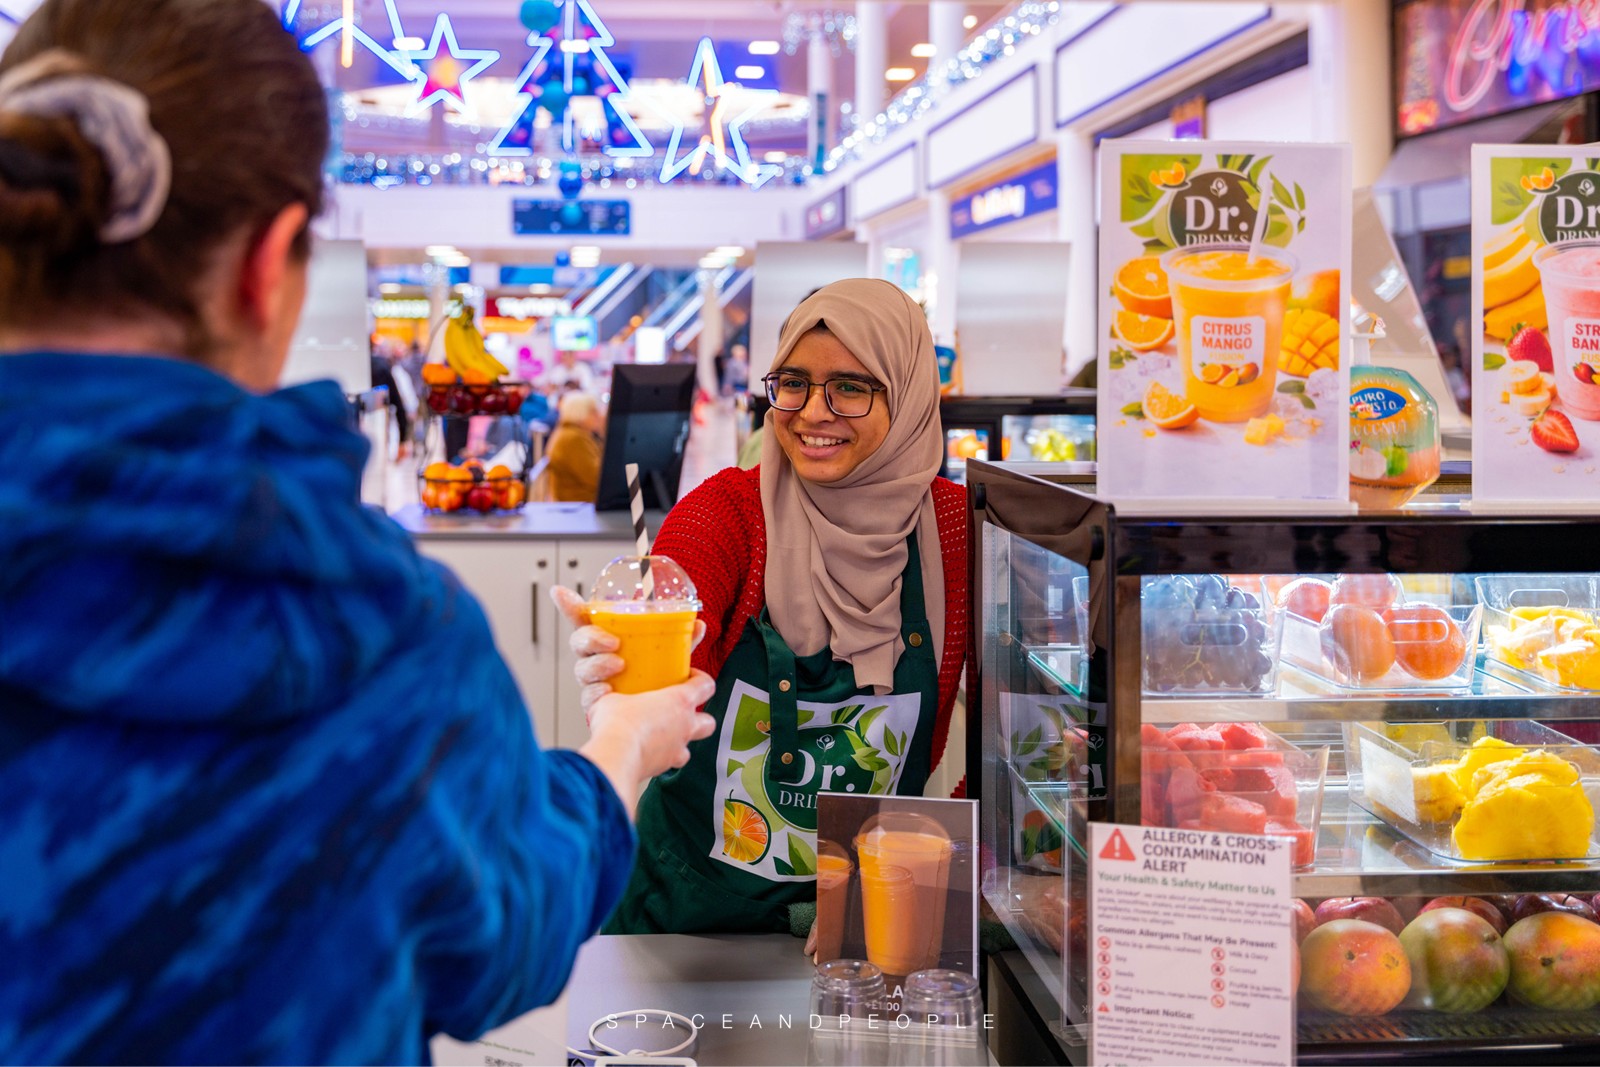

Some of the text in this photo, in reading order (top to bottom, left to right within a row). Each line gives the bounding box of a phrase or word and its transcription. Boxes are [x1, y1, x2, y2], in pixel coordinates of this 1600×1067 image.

[1184, 196, 1248, 232] Dr.
[1186, 233, 1249, 247] DRINKS
[1202, 322, 1252, 336] CITRUS
[1201, 336, 1252, 351] MANGO
[1208, 351, 1245, 361] FUSION
[1352, 391, 1385, 404] PURO
[1142, 830, 1282, 851] ALLERGY & CROSS-
[1143, 843, 1265, 865] CONTAMINATION
[1143, 859, 1187, 873] ALERT
[1098, 870, 1276, 896] Your Health & Safety Matter to Us
[1097, 924, 1277, 949] Common Allergens That May Be Present:
[1114, 1004, 1195, 1019] Important Notice:
